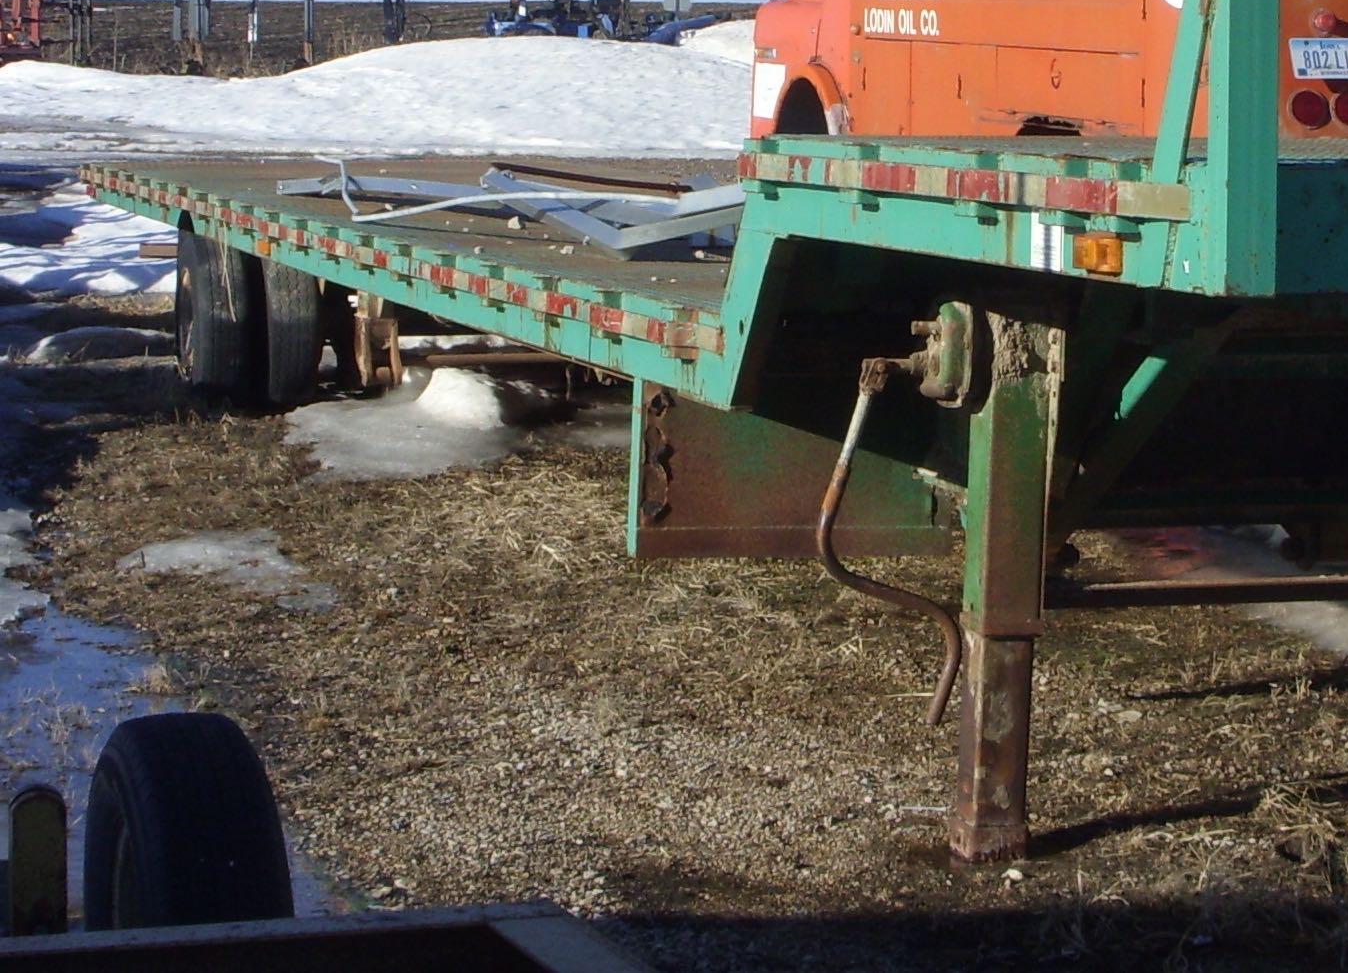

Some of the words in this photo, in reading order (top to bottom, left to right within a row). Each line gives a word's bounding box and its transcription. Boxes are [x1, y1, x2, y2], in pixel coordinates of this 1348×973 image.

[863, 7, 895, 34] LODIN
[898, 8, 917, 35] OIL
[920, 9, 940, 36] CO.
